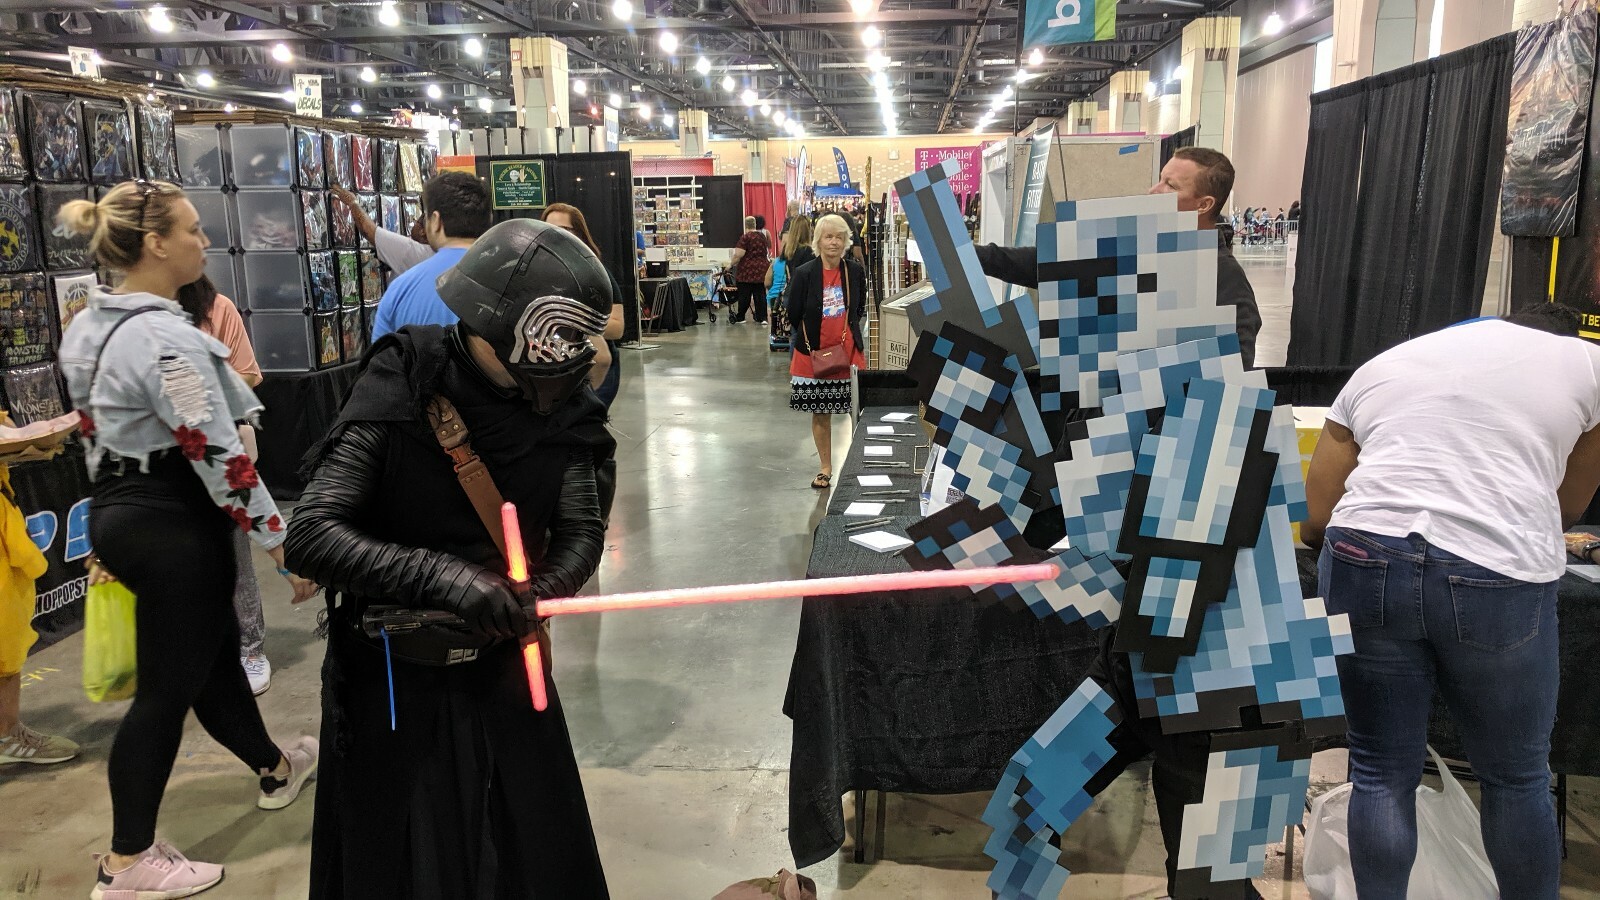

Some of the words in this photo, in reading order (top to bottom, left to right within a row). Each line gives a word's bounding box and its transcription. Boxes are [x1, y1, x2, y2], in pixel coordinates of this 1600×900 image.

[297, 98, 321, 110] DECALS
[6, 345, 46, 357] MONSTER
[890, 343, 907, 355] BATH
[888, 355, 909, 368] FITTER
